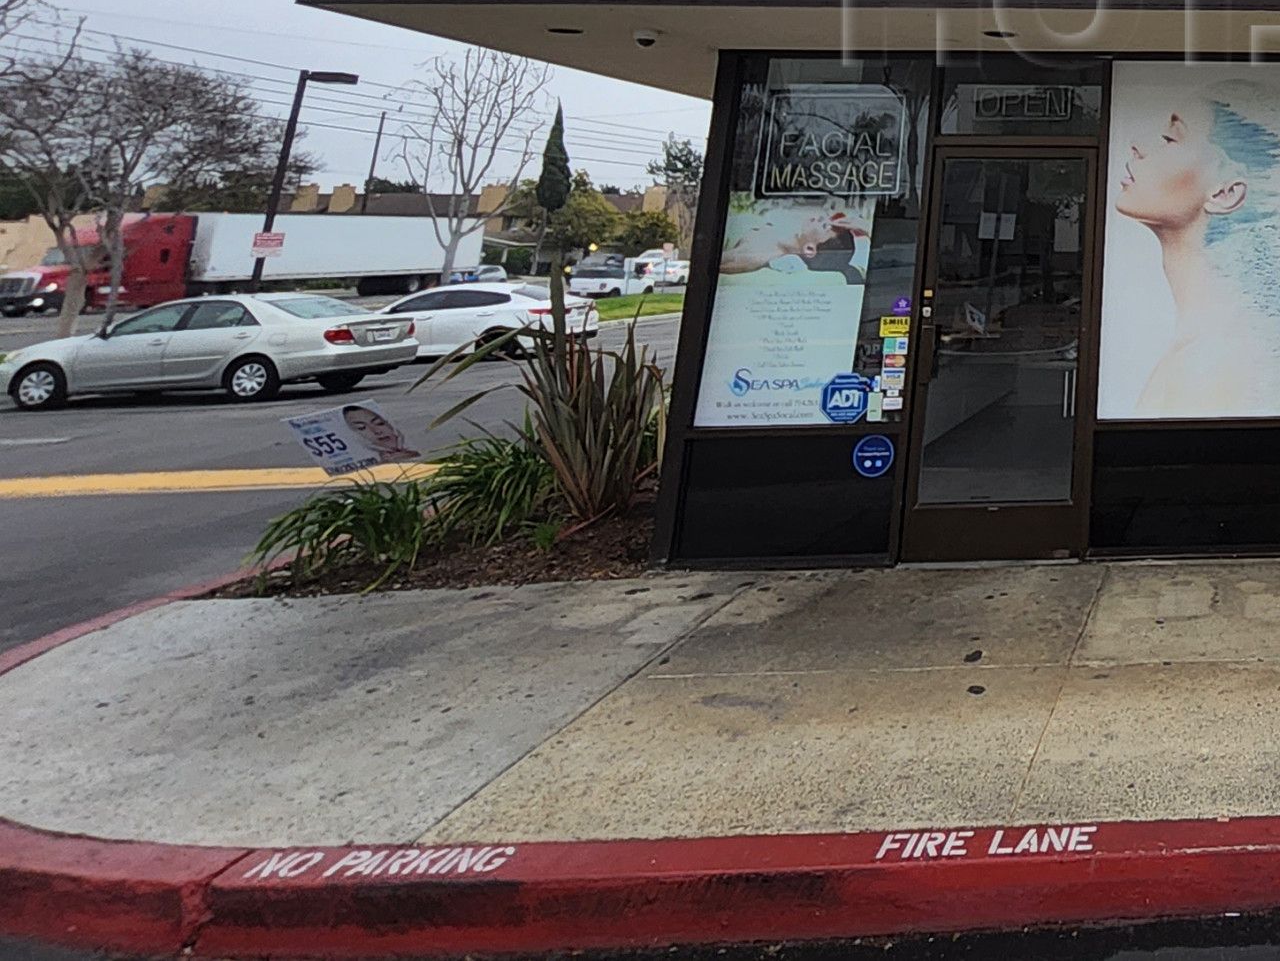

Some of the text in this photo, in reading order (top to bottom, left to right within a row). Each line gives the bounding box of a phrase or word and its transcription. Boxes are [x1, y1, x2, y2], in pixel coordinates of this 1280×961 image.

[980, 89, 1066, 117] OPEN
[779, 131, 892, 158] FACIAL
[770, 160, 897, 189] MASSAGE
[828, 389, 860, 409] ADT
[875, 826, 1098, 859] FIRE LANE
[243, 845, 515, 879] NO PARKING
